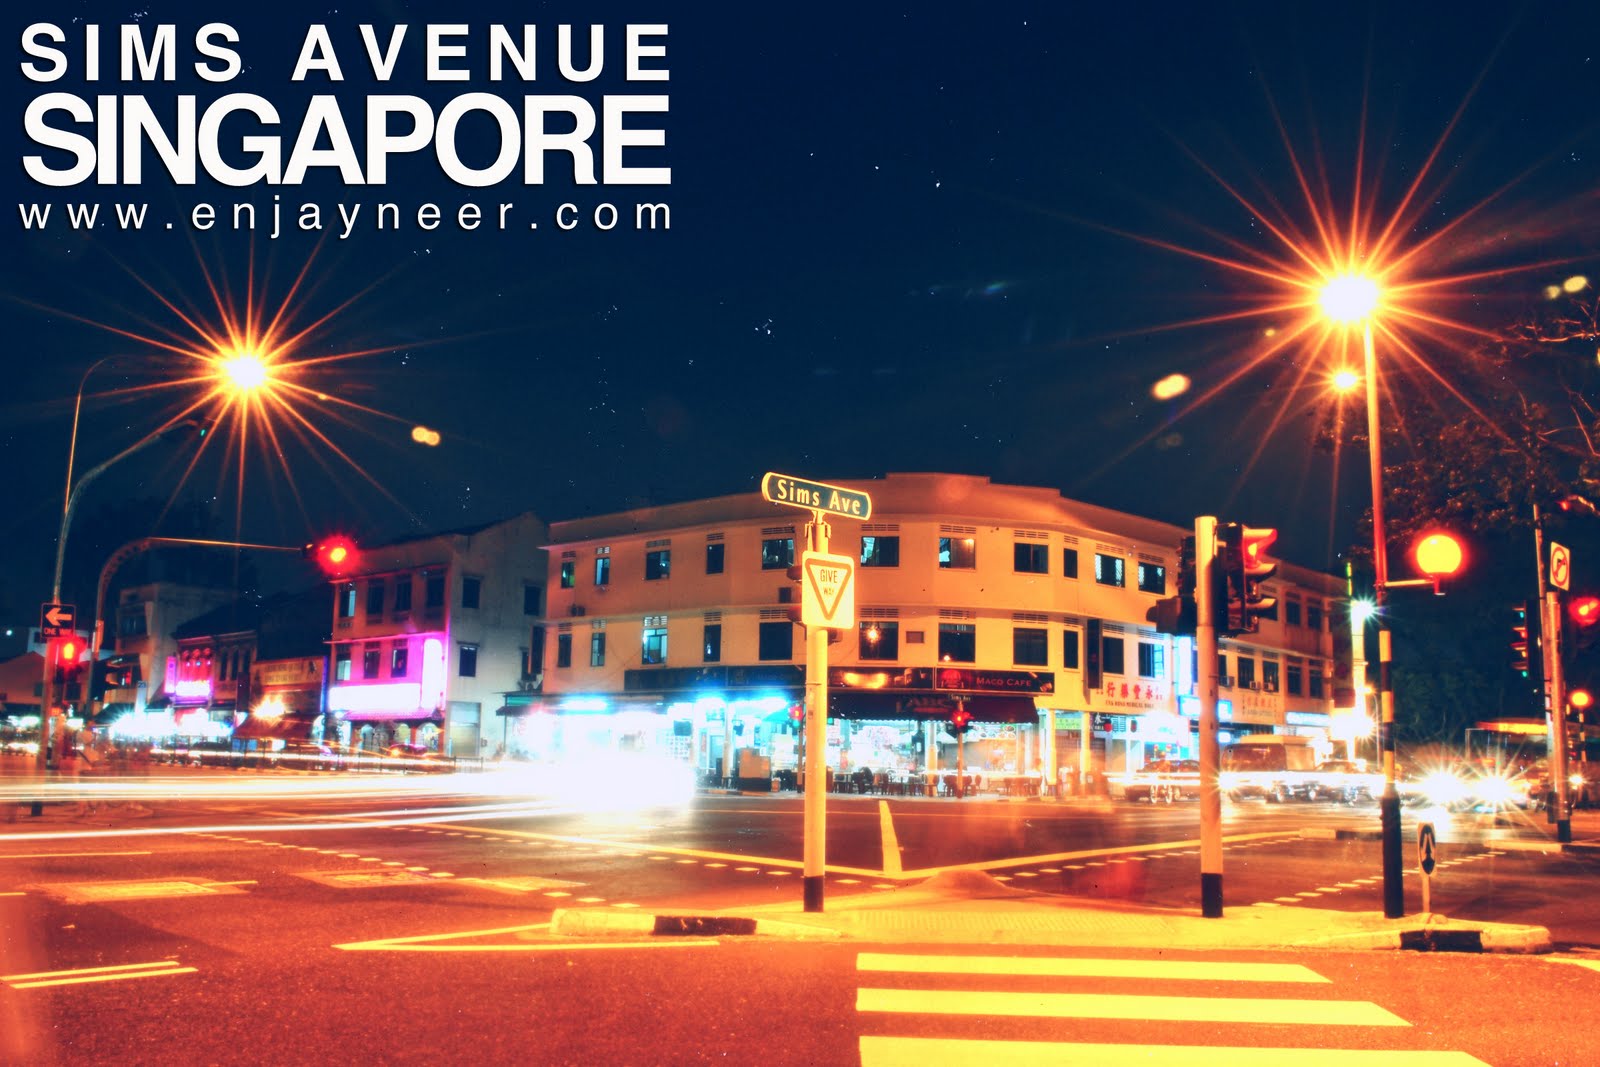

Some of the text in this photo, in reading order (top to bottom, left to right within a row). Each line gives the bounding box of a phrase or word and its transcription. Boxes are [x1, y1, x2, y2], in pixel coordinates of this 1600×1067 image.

[777, 479, 861, 515] Sims Ave
[820, 569, 838, 583] GIVE
[976, 677, 1032, 687] MACO CAFE
